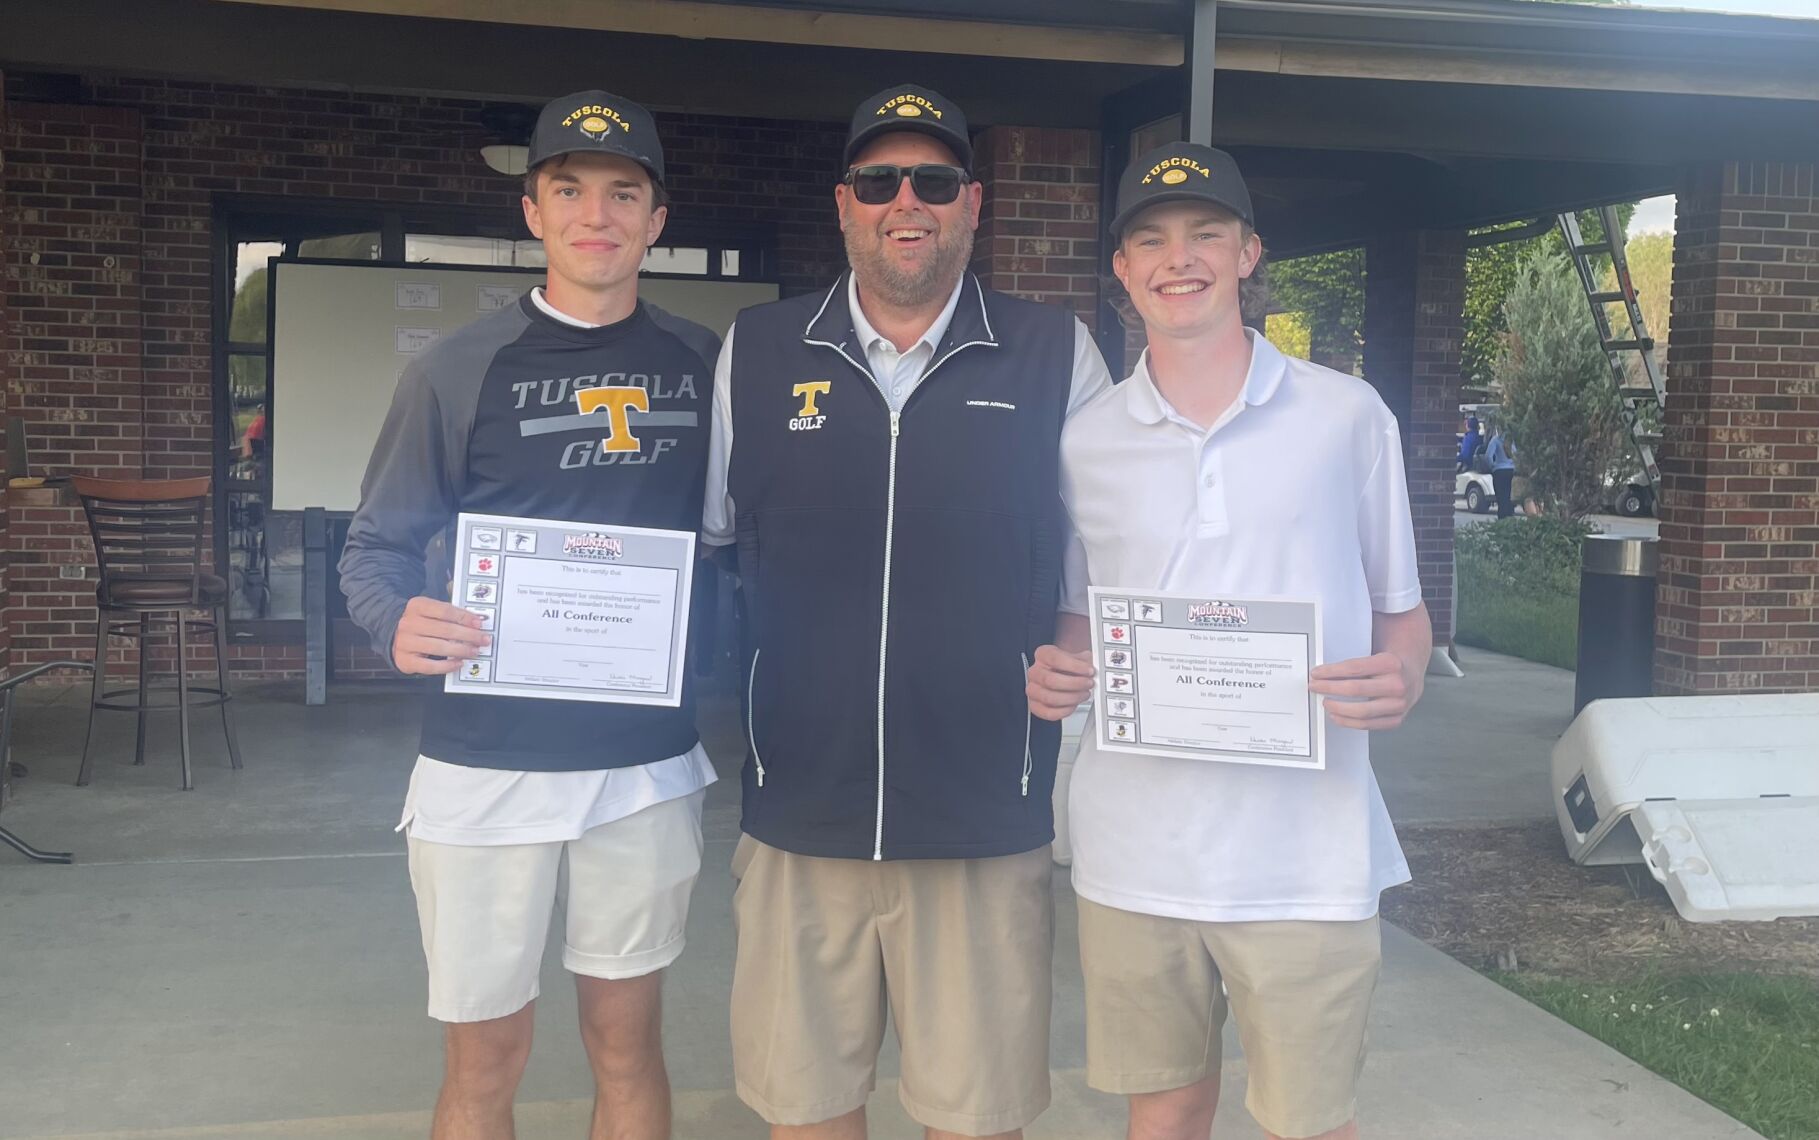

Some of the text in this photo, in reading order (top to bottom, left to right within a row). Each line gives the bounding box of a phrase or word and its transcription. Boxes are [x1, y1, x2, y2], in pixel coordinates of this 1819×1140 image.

[876, 94, 943, 120] TUSCOLA
[562, 105, 630, 132] TUSCOLA
[1141, 157, 1210, 178] TUSCOLA
[792, 381, 831, 417] T
[989, 401, 1015, 411] ARMOUR
[574, 385, 650, 454] T
[789, 415, 827, 431] GOLF
[563, 534, 623, 555] MOUNTAIN
[570, 547, 616, 556] SEVEN
[542, 609, 633, 624] All Conference
[1187, 604, 1248, 624] MOUNTAIN
[1195, 616, 1240, 624] SEVEN
[1189, 633, 1202, 641] This
[1176, 675, 1266, 689] All Conference
